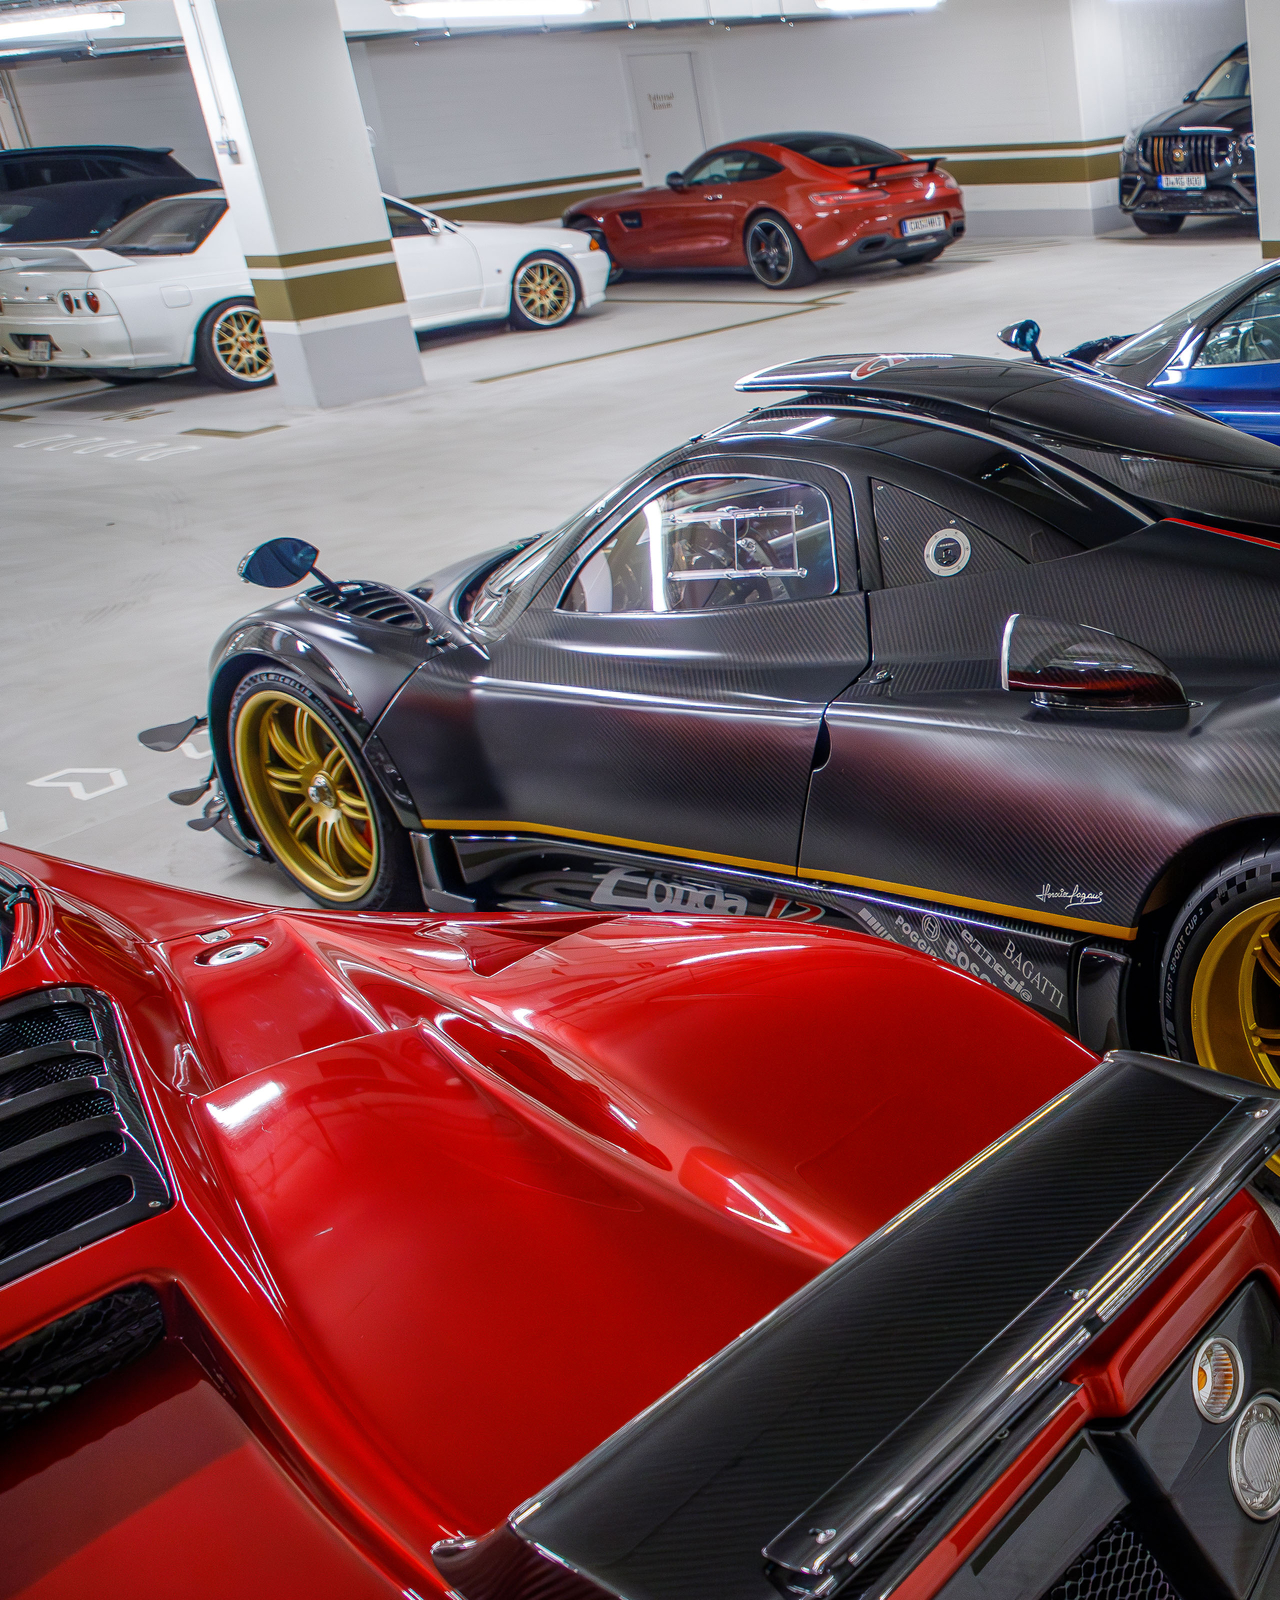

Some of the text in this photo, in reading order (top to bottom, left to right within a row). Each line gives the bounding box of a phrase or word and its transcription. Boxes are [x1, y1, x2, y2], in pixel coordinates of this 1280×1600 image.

[1003, 939, 1065, 1010] BAGATTI
[1170, 935, 1186, 974] SPORT
[1184, 914, 1198, 937] CUP
